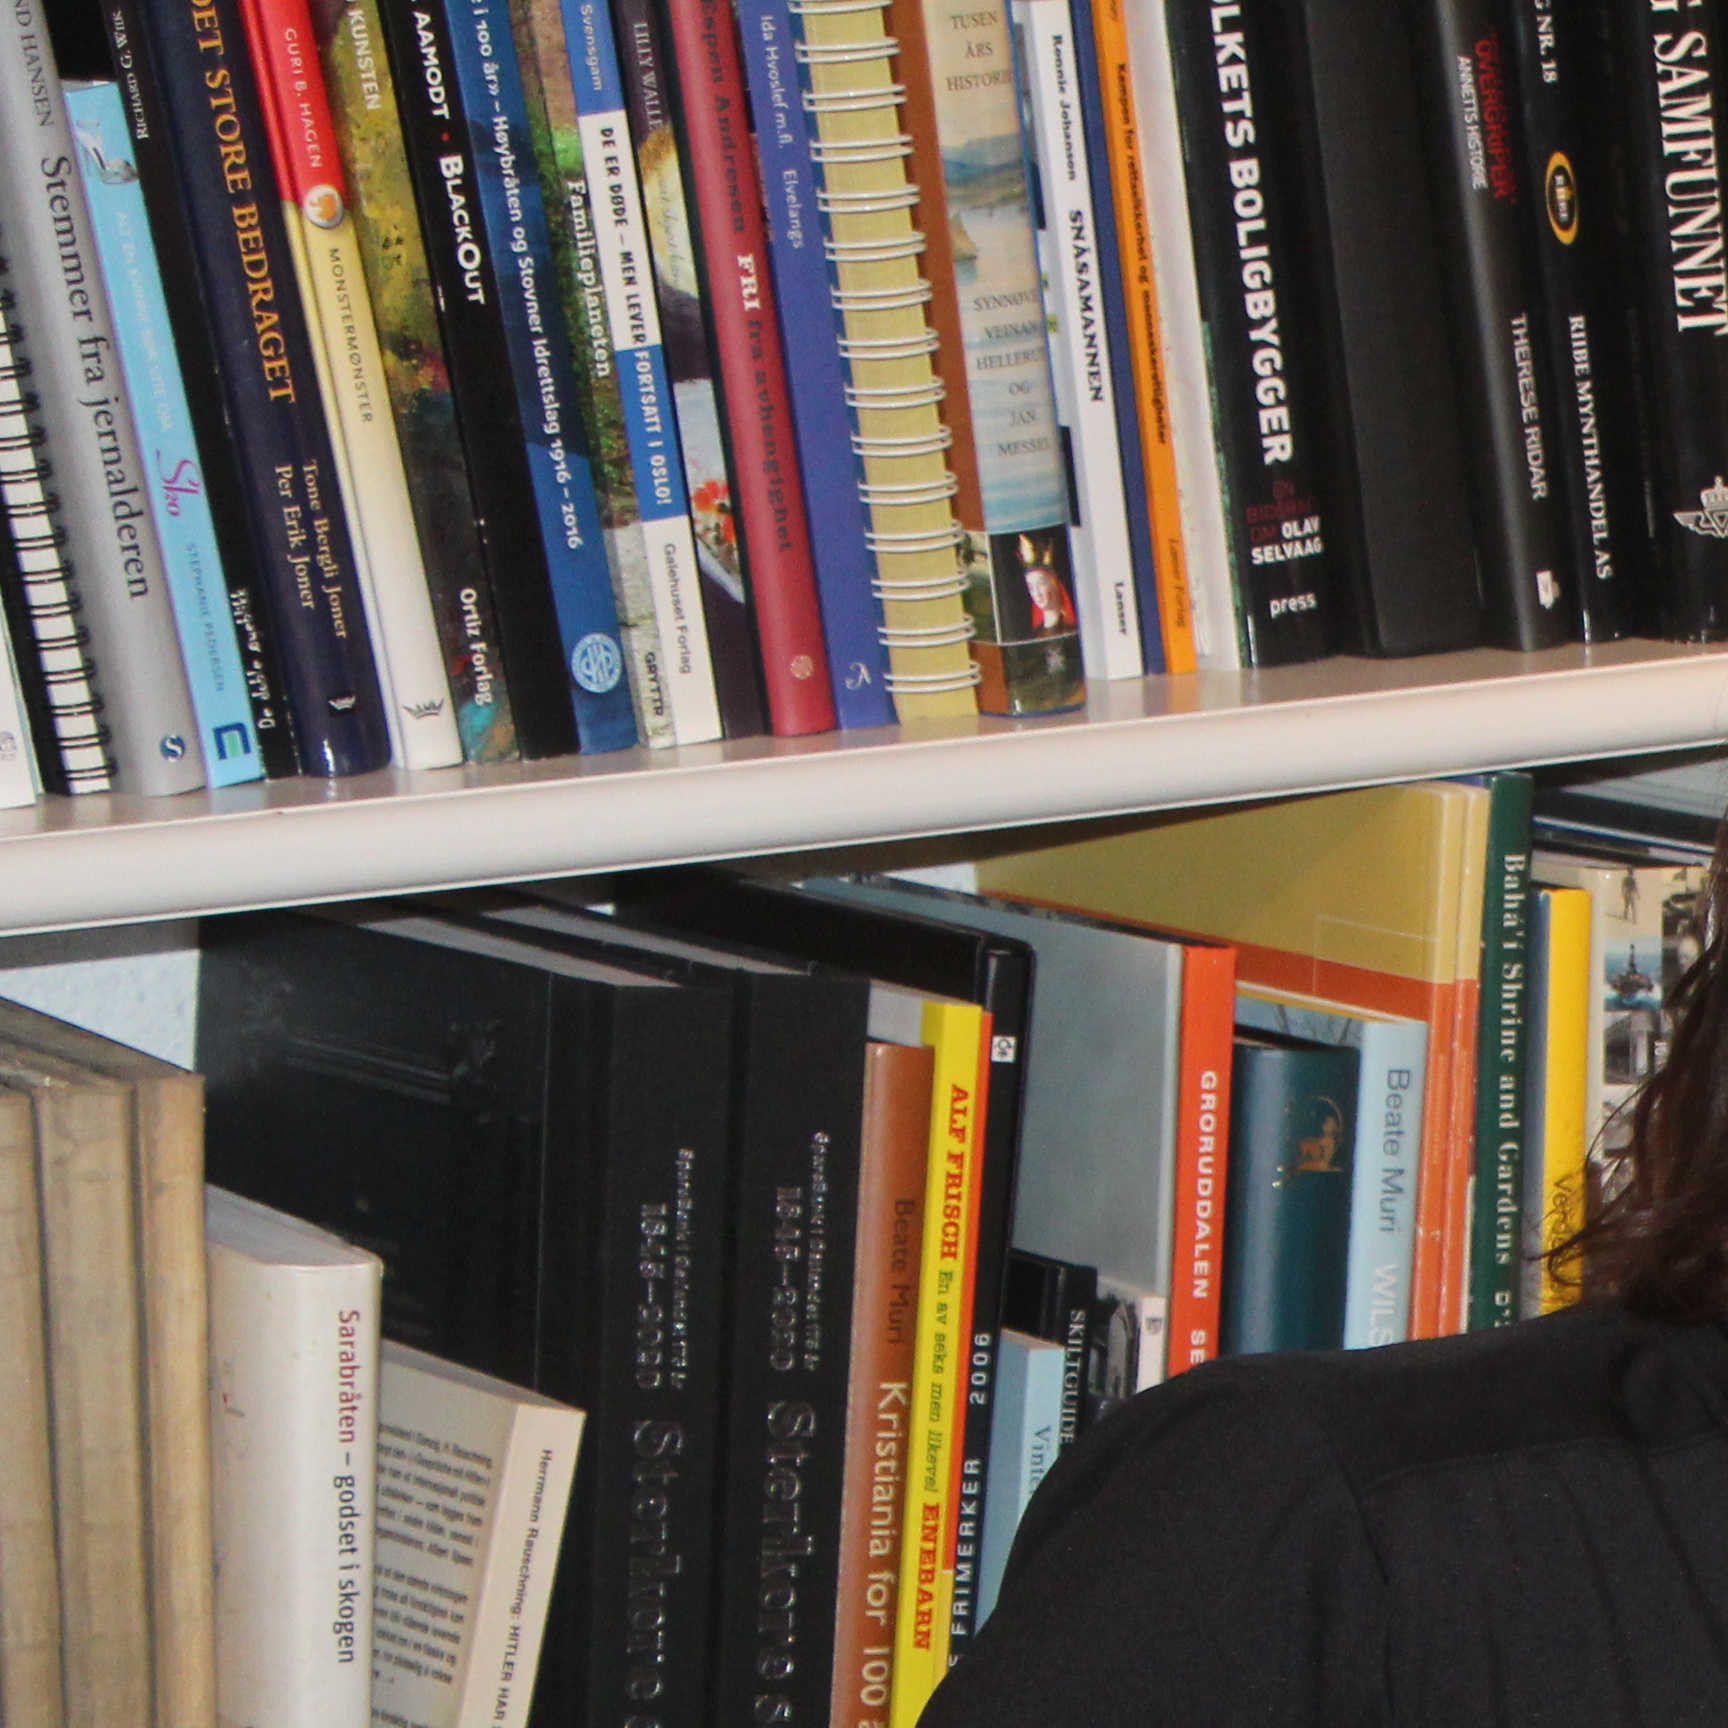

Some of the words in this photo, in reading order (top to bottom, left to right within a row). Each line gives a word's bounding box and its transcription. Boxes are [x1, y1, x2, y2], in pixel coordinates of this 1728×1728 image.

[285, 28, 304, 74] GURI
[476, 21, 494, 57] 100
[633, 20, 652, 69] LILLY
[761, 14, 776, 42] Ida
[950, 11, 998, 30] TUSEN
[964, 40, 994, 58] ÅRS
[21, 34, 54, 127] HANSEN
[295, 80, 308, 98] B.
[348, 9, 381, 110] KUNSTEN
[413, 10, 451, 119] AAMODT
[764, 46, 786, 111] Hvoslef
[1051, 33, 1071, 92] Ronnie
[1457, 55, 1480, 122] ANNETTS
[1542, 64, 1558, 84] 18
[126, 72, 149, 139] RICHARD
[299, 102, 324, 168] HAGEN
[491, 114, 523, 222] Høybråten
[600, 126, 616, 148] DE
[603, 153, 621, 177] ER
[713, 94, 745, 233] Andresen
[1059, 95, 1078, 181] Johanson
[1468, 124, 1490, 191] HISTORIE
[608, 180, 629, 227] DØDE
[1116, 63, 1132, 126] Kampen
[1124, 128, 1135, 149] for
[1140, 264, 1150, 283] og
[41, 154, 95, 322] Stemmer
[204, 67, 253, 194] STORE
[231, 203, 297, 404] BEDRAGET
[783, 168, 804, 249] Elvelangs
[510, 228, 529, 254] og
[619, 250, 638, 284] MEN
[518, 256, 542, 332] Stovner
[566, 178, 612, 378] Familieplaneten
[736, 253, 760, 311] FRI
[1069, 208, 1106, 403] SNÅSAMANNEN
[328, 247, 374, 423] MONSTERMØNSTER
[623, 286, 648, 345] LEVER
[747, 318, 765, 358] fra
[1229, 158, 1292, 466] BOLIGBYGGER
[77, 334, 109, 386] fra
[1568, 314, 1590, 376] RIIBE
[531, 338, 561, 435] Idrettslag
[632, 350, 662, 435] FORTSATT
[1510, 312, 1540, 424] THERESE
[1526, 427, 1549, 501] RIDAR
[275, 464, 292, 500] Per
[301, 458, 320, 510] Tone
[550, 438, 572, 490] 1916
[650, 454, 673, 505] OSLO!
[754, 366, 793, 553] avhengighet
[1576, 382, 1608, 538] MYNTHANDEL
[77, 394, 150, 598] jernalderen
[561, 502, 585, 551] 2016
[1281, 515, 1321, 538] OLAV
[282, 504, 306, 551] Erik
[313, 518, 338, 580] Bergli
[1251, 537, 1325, 566] SELVAAG
[287, 553, 315, 611] Joner
[1595, 551, 1615, 581] AS
[321, 583, 347, 640] Joner
[459, 587, 488, 638] Ortiz
[1114, 580, 1129, 636] Lanser
[1268, 592, 1318, 620] press
[470, 641, 494, 706] Forlag
[675, 625, 692, 675] Forlag
[1500, 961, 1523, 1063] Shrine
[947, 1083, 970, 1143] ALF
[1382, 1068, 1412, 1157] Beate
[1498, 1076, 1521, 1131] and
[939, 1150, 966, 1261] FRISCH
[1193, 1070, 1218, 1300] GRORUDDALEN
[1379, 1167, 1406, 1233] Muri
[1495, 1142, 1521, 1267] Gardens
[891, 1198, 916, 1275] Beate
[938, 1269, 953, 1295] En
[887, 1284, 912, 1345] Muri
[936, 1303, 949, 1327] av
[338, 1309, 362, 1444] Sarabråten
[931, 1331, 947, 1372] seks
[1059, 1309, 1087, 1444] SKILTGUIDE
[928, 1382, 944, 1425] men
[529, 1449, 553, 1523] Herrmann
[868, 1381, 909, 1558] Kristiania
[922, 1431, 944, 1494] likevel
[949, 1456, 982, 1638] FRIMERKER
[969, 1332, 993, 1406] 2006
[333, 1474, 358, 1558] godset
[508, 1528, 539, 1620] Rauschning:
[863, 1571, 897, 1627] for
[914, 1502, 940, 1652] ENEBARN
[332, 1577, 360, 1664] skogen
[498, 1625, 520, 1682] HITLER
[858, 1647, 891, 1708] 100
[493, 1684, 511, 1722] HAR
